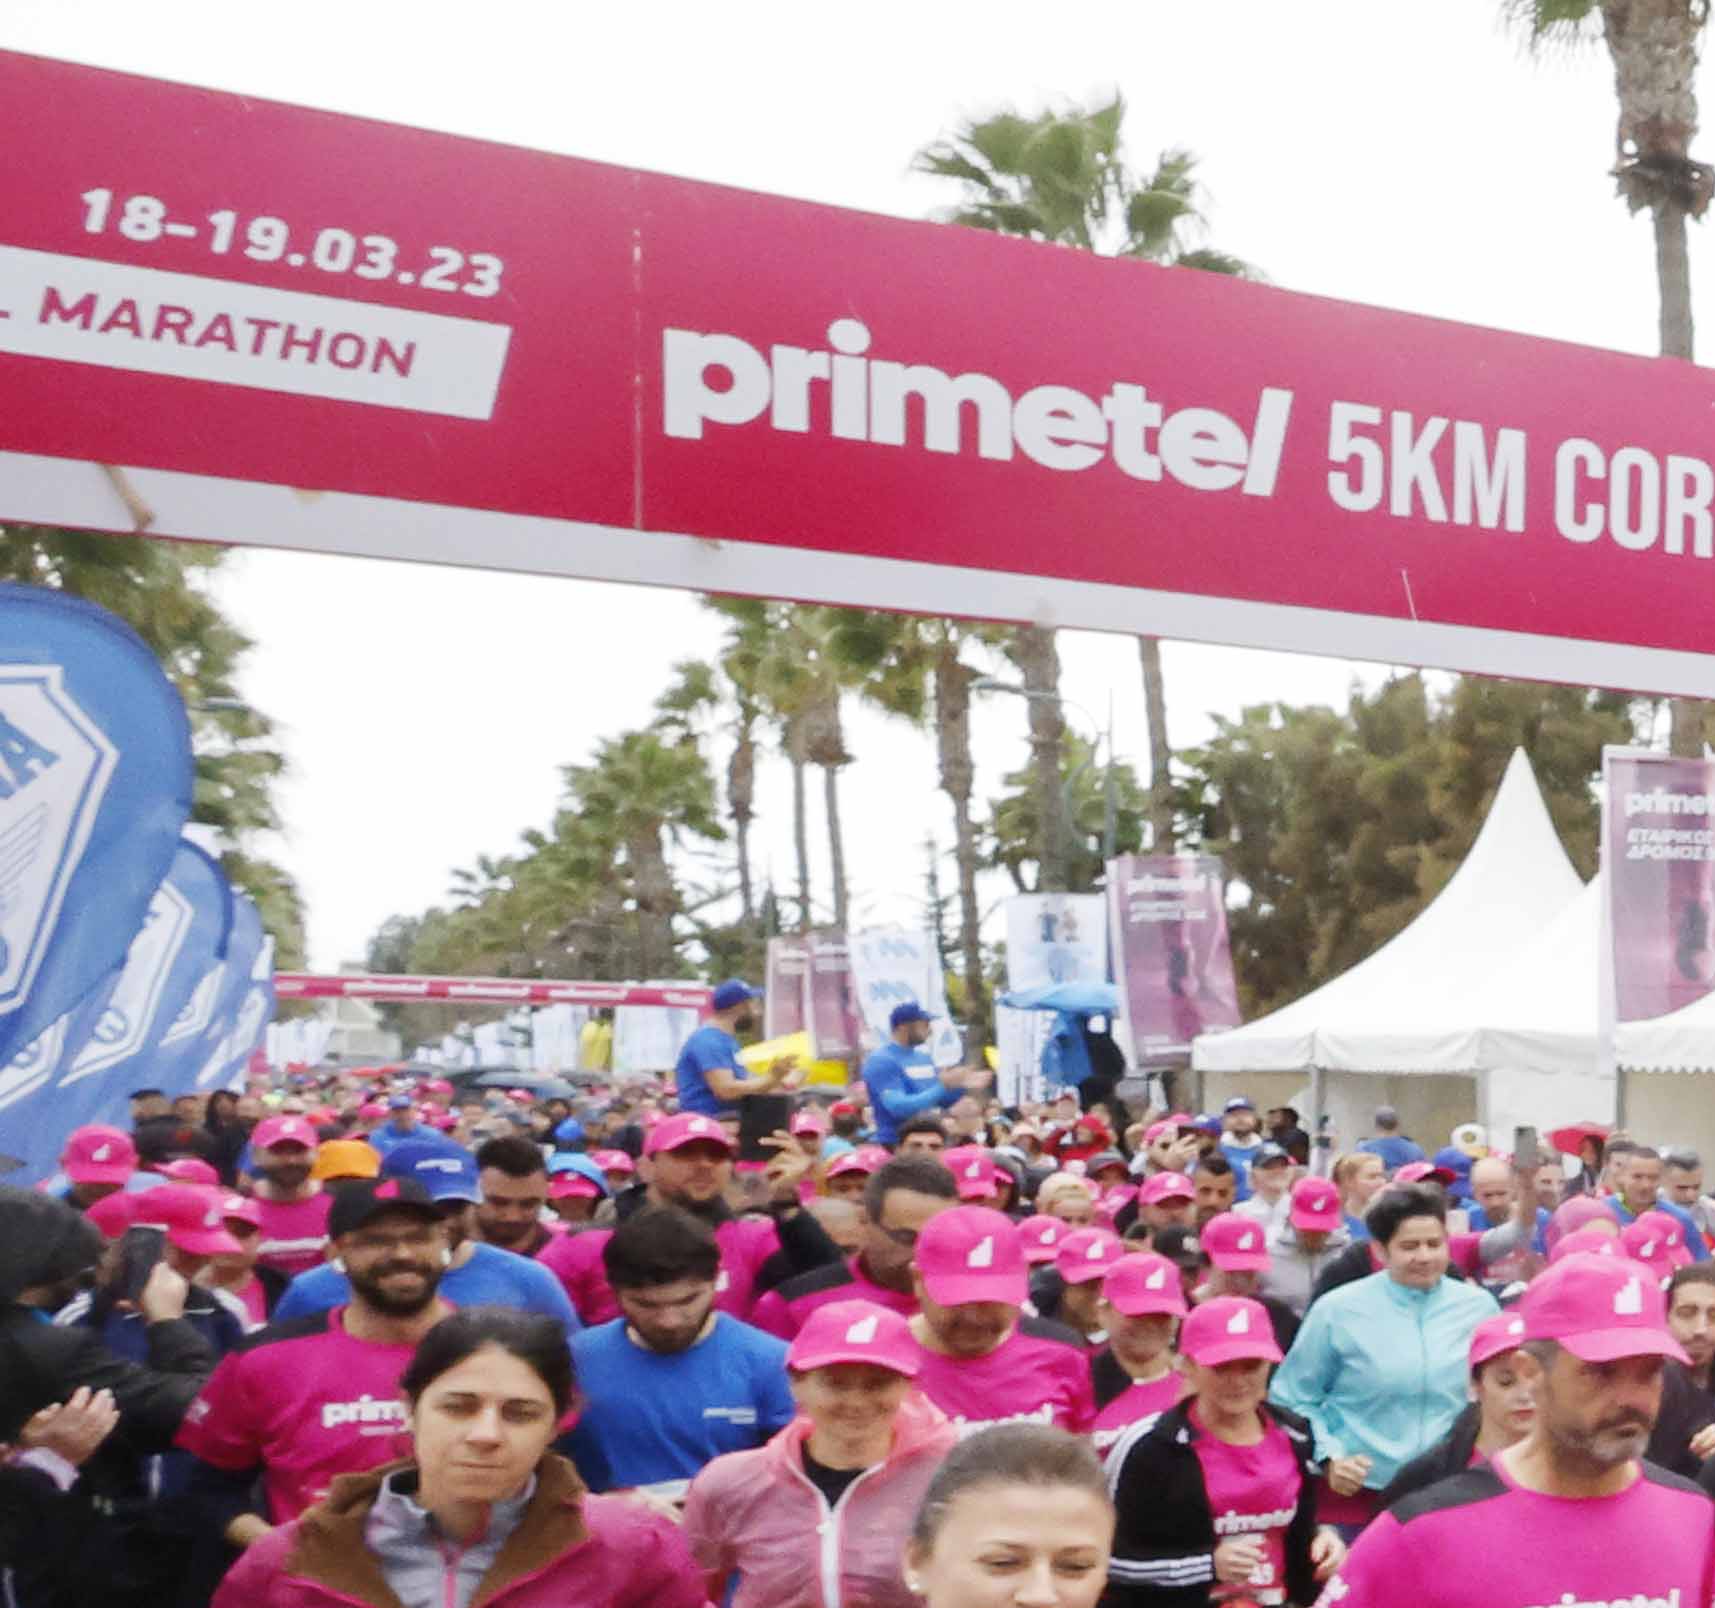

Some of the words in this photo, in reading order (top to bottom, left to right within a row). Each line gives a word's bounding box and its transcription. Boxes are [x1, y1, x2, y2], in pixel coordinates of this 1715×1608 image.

[82, 187, 505, 298] 18-19.03.23
[39, 286, 417, 379] MARATHON
[663, 318, 1294, 497] primetel
[1327, 400, 1526, 533] 5KM
